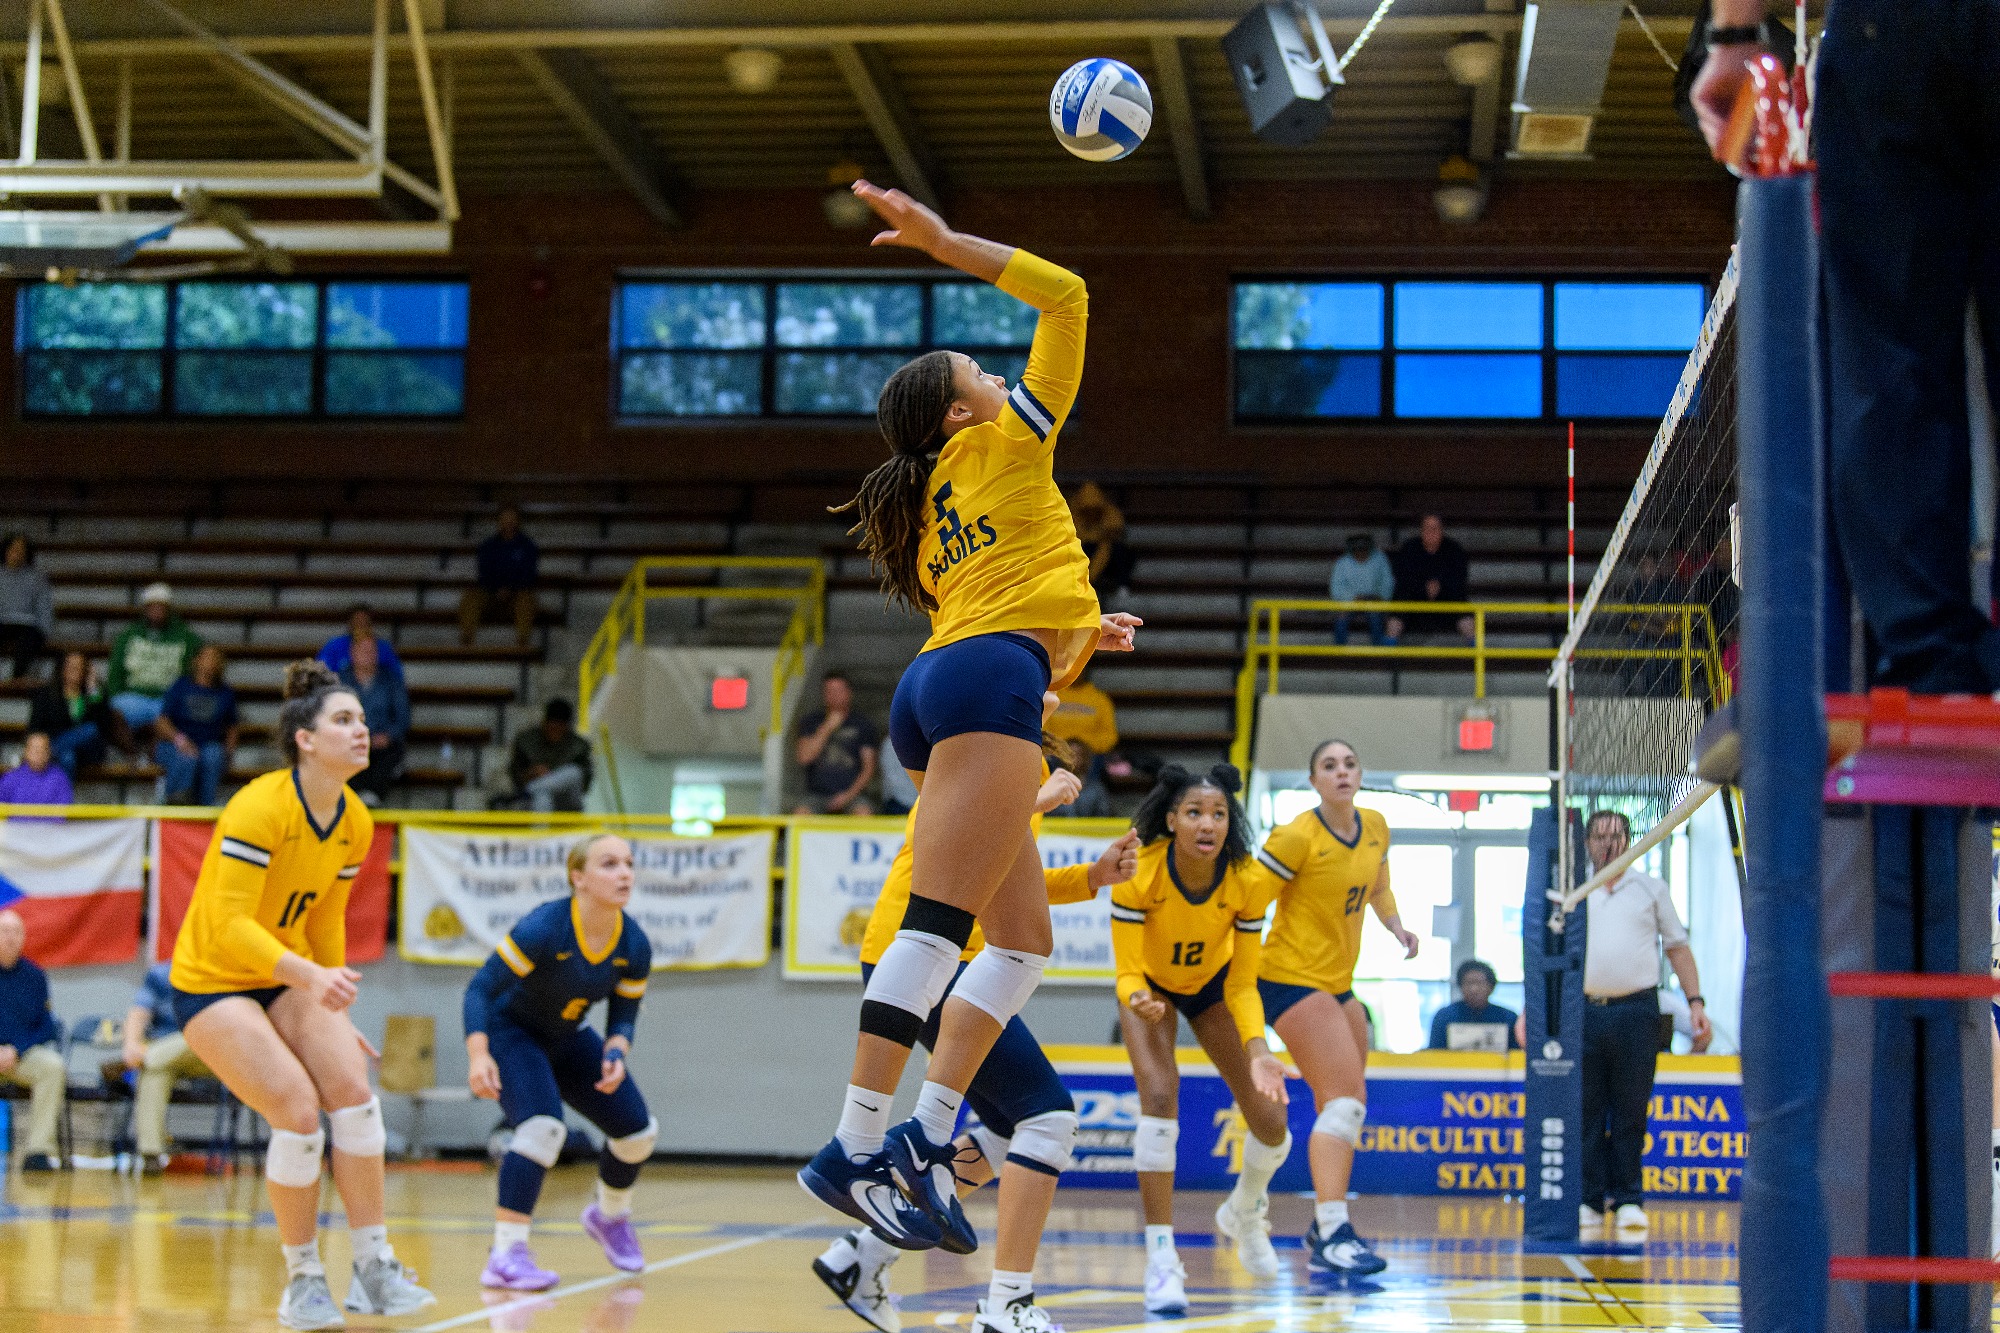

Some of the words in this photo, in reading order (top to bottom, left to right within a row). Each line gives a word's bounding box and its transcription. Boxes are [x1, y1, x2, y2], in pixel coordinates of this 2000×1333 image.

[931, 479, 963, 547] 5
[465, 840, 566, 866] Atlant
[631, 840, 747, 878] hapter
[1344, 884, 1368, 918] 21
[1170, 941, 1206, 967] 12
[1442, 1091, 1526, 1119] NORT
[1354, 1125, 1526, 1155] GRICULTU
[1658, 1129, 1749, 1159] TECH
[1640, 1165, 1733, 1194] RSITY
